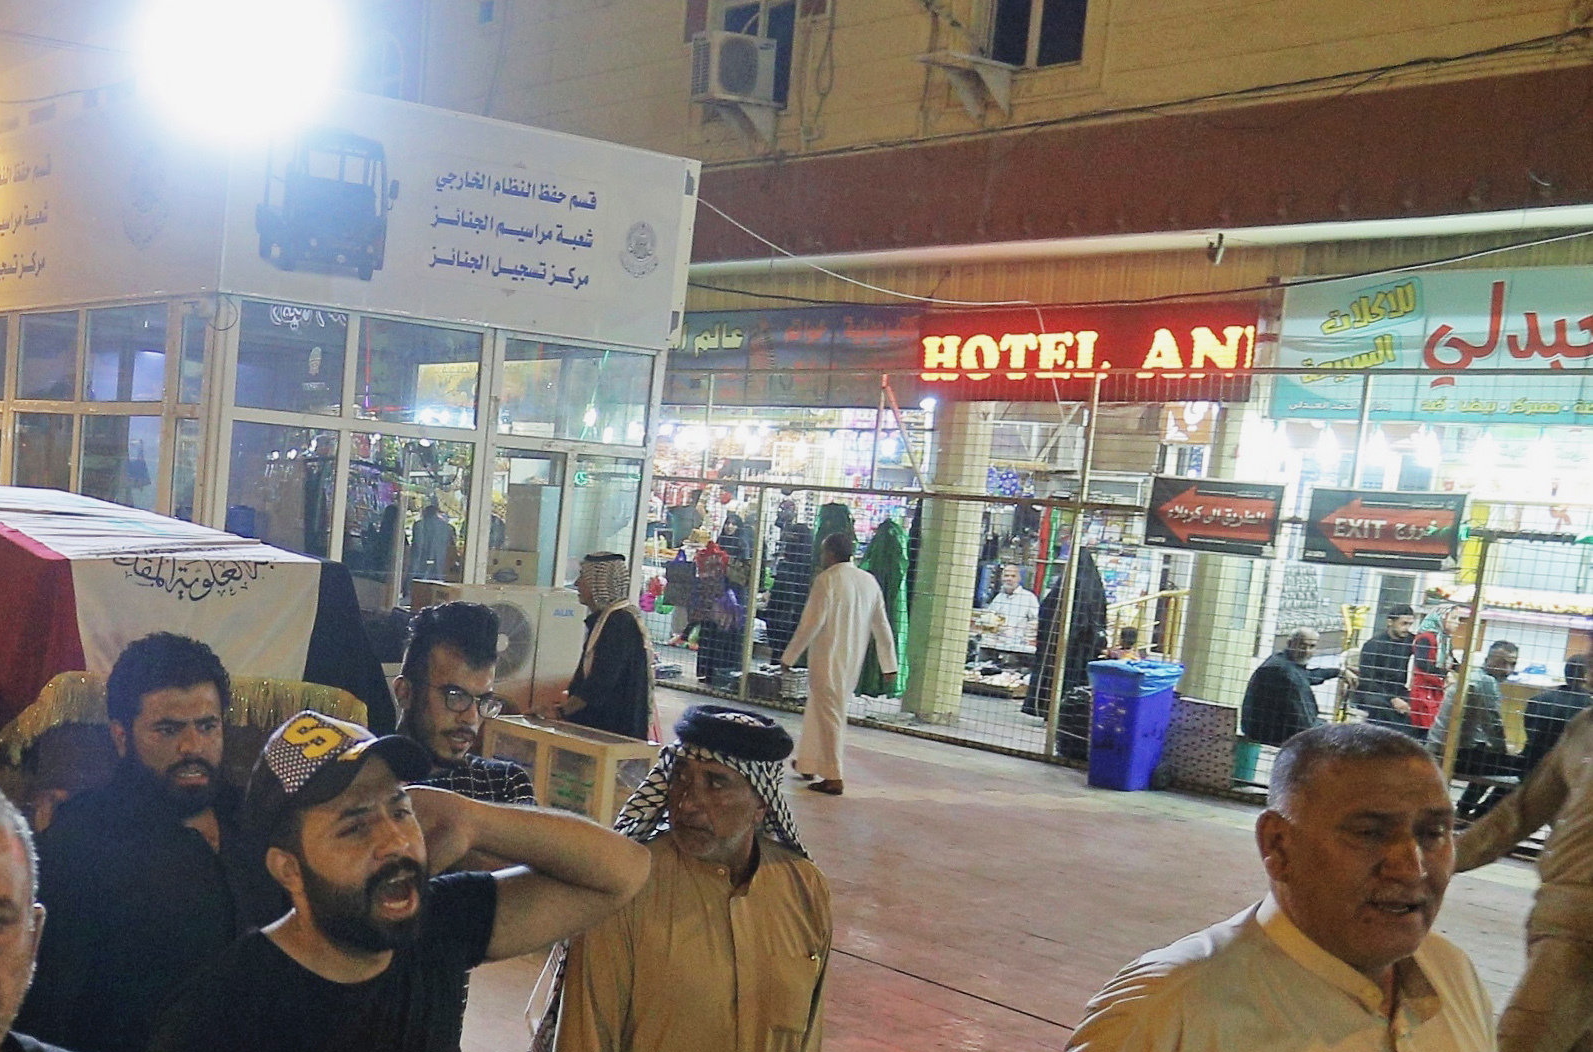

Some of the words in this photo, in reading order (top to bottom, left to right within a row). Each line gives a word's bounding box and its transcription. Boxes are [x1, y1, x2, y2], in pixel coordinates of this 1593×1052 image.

[436, 171, 491, 192] الخارجي
[493, 177, 536, 199] النظام
[538, 182, 567, 204] حفظ
[569, 191, 597, 211] قسم
[430, 206, 494, 235] الجنائز
[496, 219, 553, 245] مراسيم
[556, 225, 594, 250] شعبة
[429, 246, 490, 274] الجنائز
[492, 257, 547, 281] تسجيل
[548, 265, 589, 290] مركز
[694, 322, 745, 358] عالم
[920, 330, 1111, 381] HOTEL
[1167, 505, 1204, 523] كربلاء
[1222, 508, 1266, 528] الطريق
[1333, 517, 1387, 539] EXIT
[1394, 519, 1438, 541] خروج
